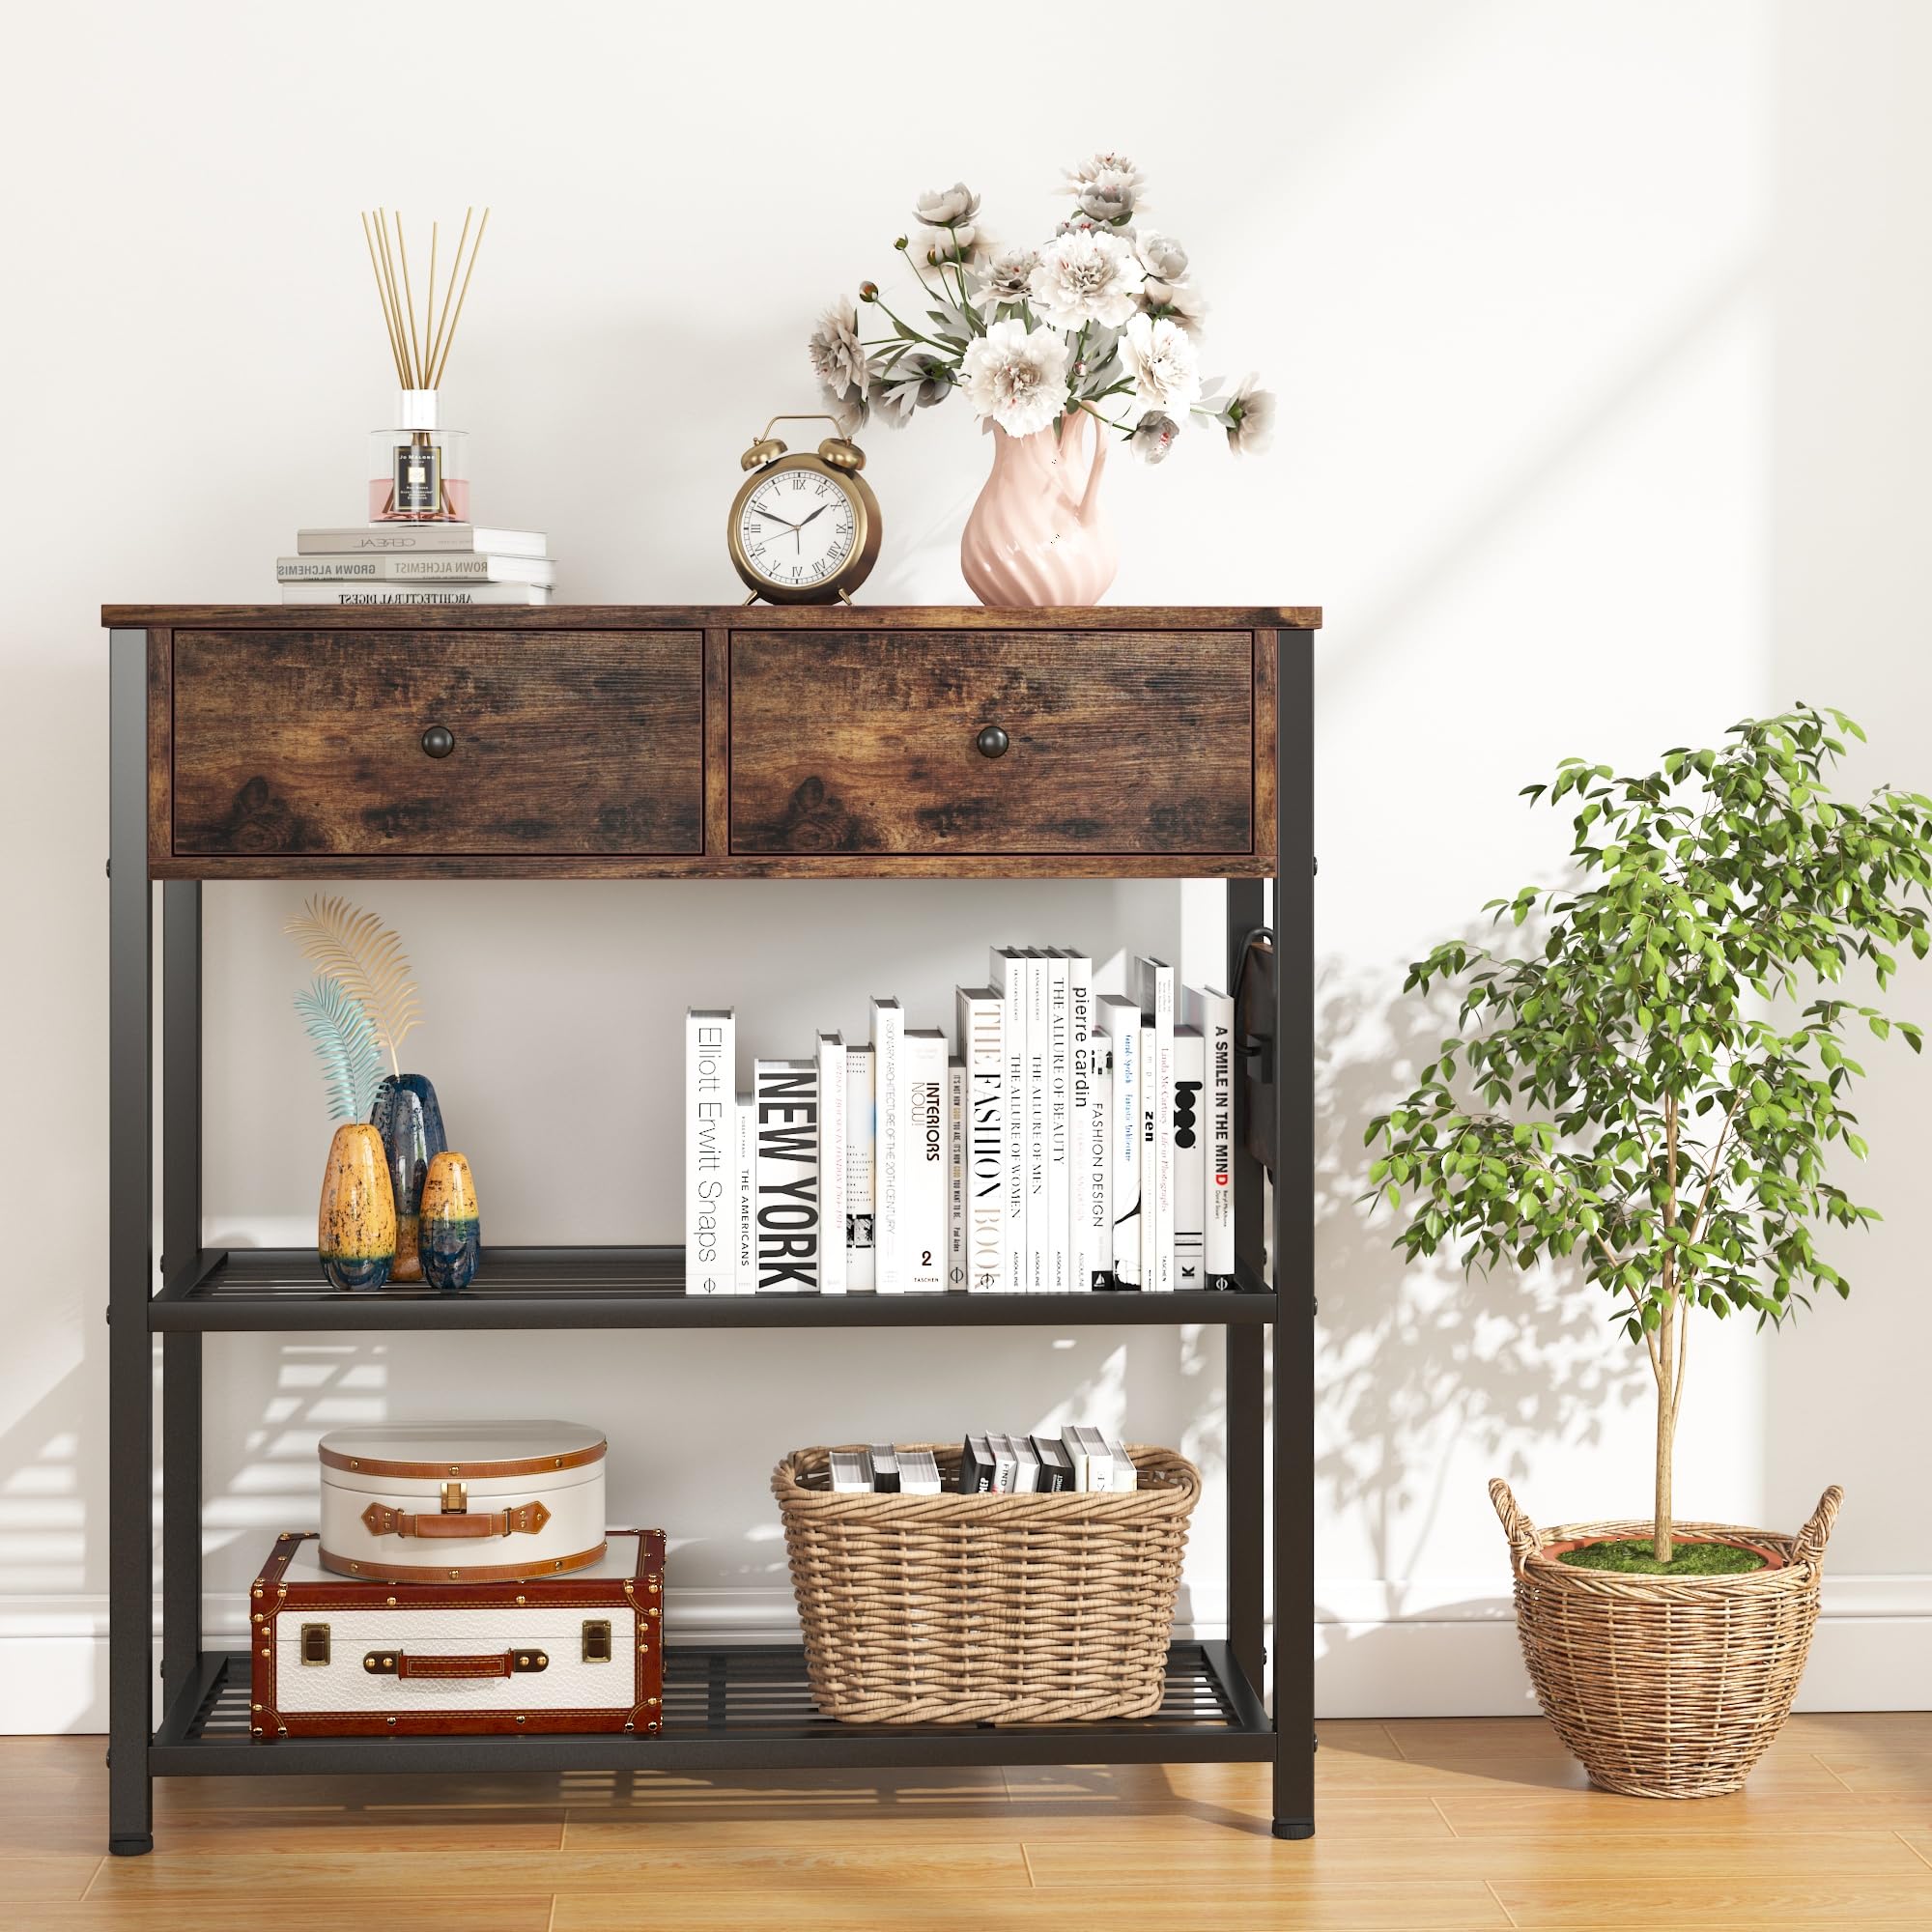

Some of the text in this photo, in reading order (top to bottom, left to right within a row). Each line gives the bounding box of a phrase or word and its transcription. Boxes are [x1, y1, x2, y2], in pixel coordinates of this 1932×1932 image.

[1053, 978, 1065, 1165] THE ALLURE OF BEAUTY
[1072, 987, 1089, 1108] pierre cardin
[886, 1062, 895, 1126] ARCHITECTURE
[911, 1082, 925, 1126] NOW!
[925, 1082, 941, 1162] INTERIORS
[1032, 1054, 1042, 1195] THE ALLURE OF MEN
[1215, 1026, 1229, 1186] A SMILE IN THE MIND
[694, 1028, 723, 1263] Elliott Erwitt Snaps
[886, 1128, 895, 1141] OF
[886, 1142, 895, 1160] THE
[974, 1004, 1002, 1291] THE FASHION BOOK
[1010, 1054, 1021, 1219] THE ALLURE OF WOMEN
[1093, 1103, 1103, 1167] FASHION
[1145, 1111, 1154, 1143] zen
[757, 1073, 819, 1289] NEW YORK
[886, 1162, 895, 1187] 20TH
[1093, 1173, 1103, 1228] DESIGN
[886, 1188, 895, 1235] CENTURY
[922, 1250, 933, 1267] 2
[1001, 1463, 1010, 1487] FIND
